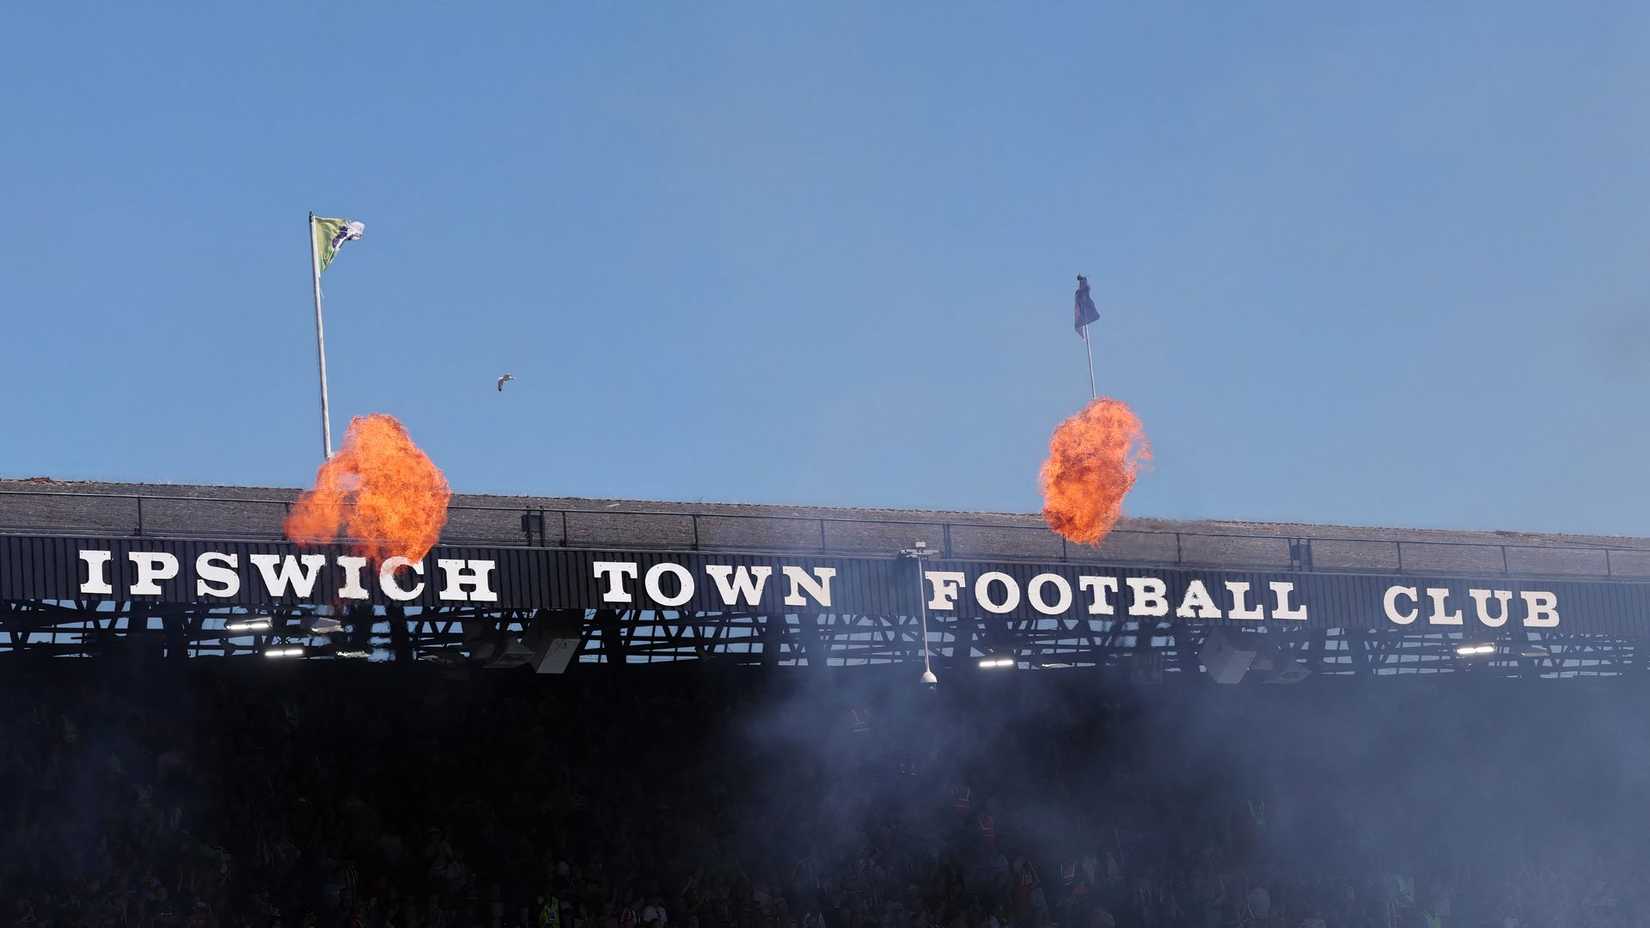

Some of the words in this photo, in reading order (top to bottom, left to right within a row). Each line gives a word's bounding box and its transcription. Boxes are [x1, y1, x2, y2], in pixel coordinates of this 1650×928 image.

[79, 549, 498, 602] IPSWICH
[592, 561, 836, 608] TOWN
[924, 571, 1308, 620] FOOTBALL
[1383, 585, 1560, 628] CLUB
